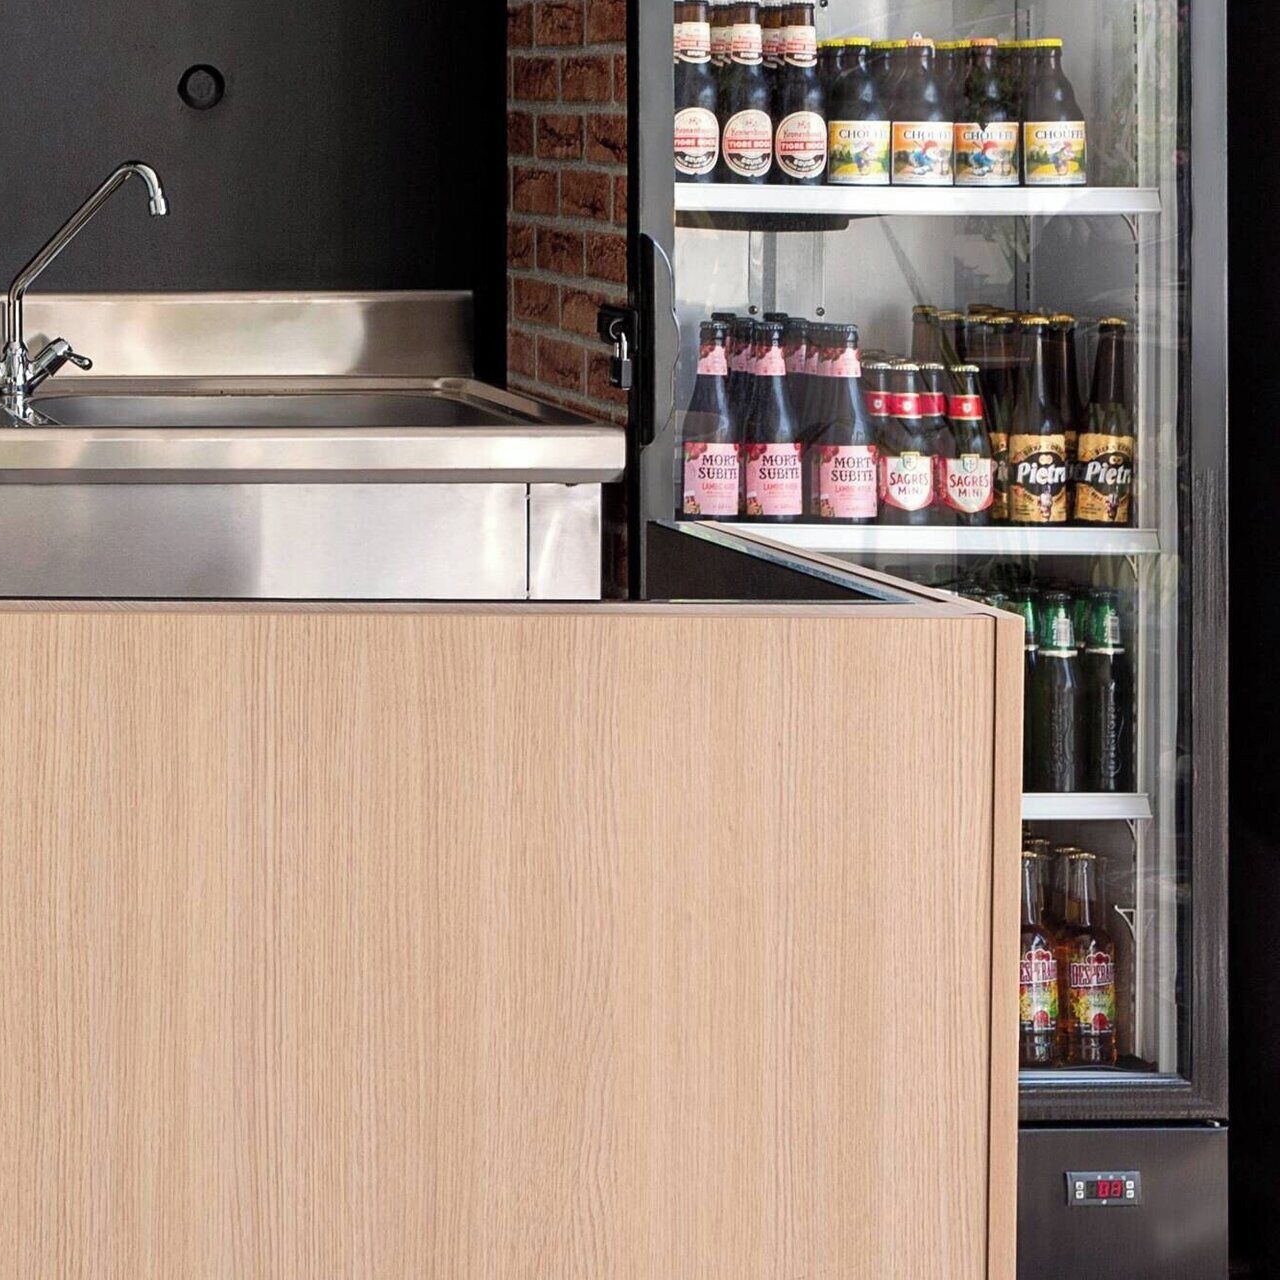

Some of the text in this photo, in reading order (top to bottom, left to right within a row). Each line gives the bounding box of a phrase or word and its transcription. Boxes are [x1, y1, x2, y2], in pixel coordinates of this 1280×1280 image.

[702, 454, 737, 466] MORT
[762, 454, 798, 467] MORT
[834, 456, 871, 469] MORT
[831, 470, 874, 482] SUBITE
[890, 472, 929, 486] SAGRES
[949, 473, 989, 487] SAGRES
